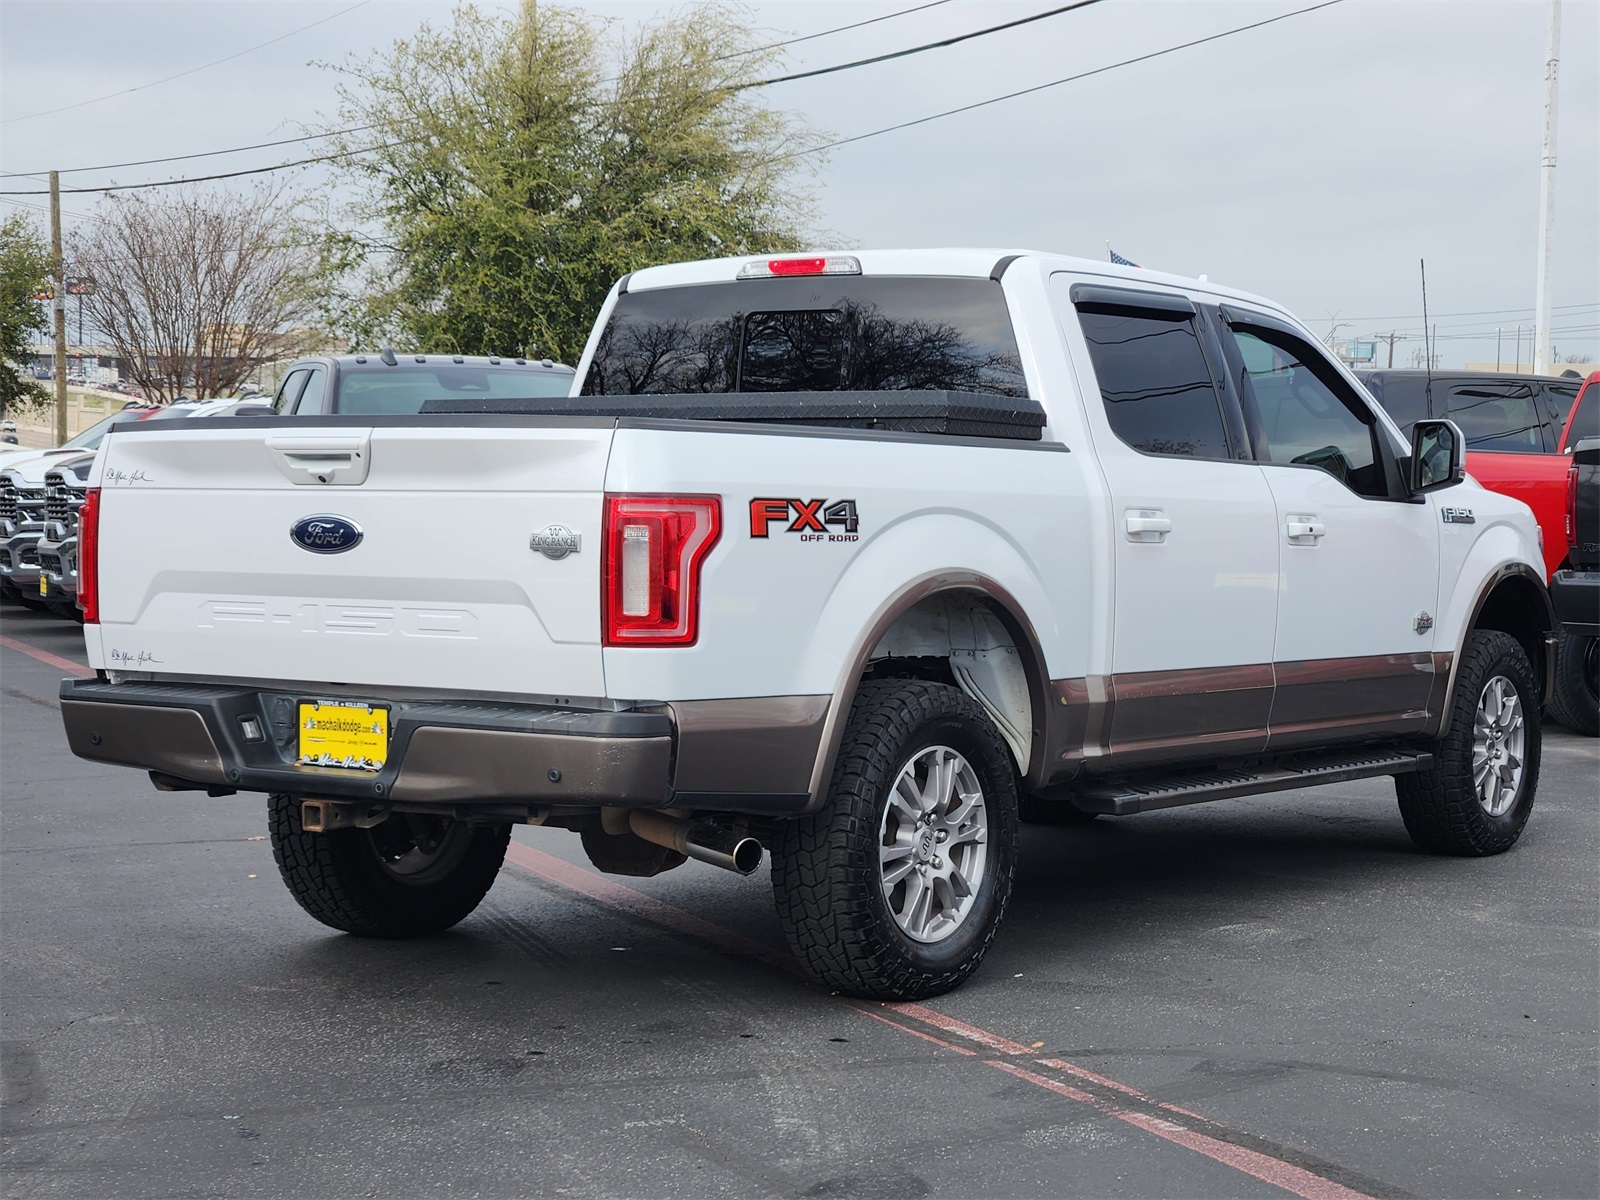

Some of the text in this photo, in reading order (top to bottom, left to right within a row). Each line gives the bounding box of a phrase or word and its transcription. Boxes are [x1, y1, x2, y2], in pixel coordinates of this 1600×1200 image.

[749, 497, 860, 539] FX4
[304, 521, 344, 545] Ford
[531, 535, 576, 547] KING RANCH
[800, 534, 859, 542] OFF ROAD
